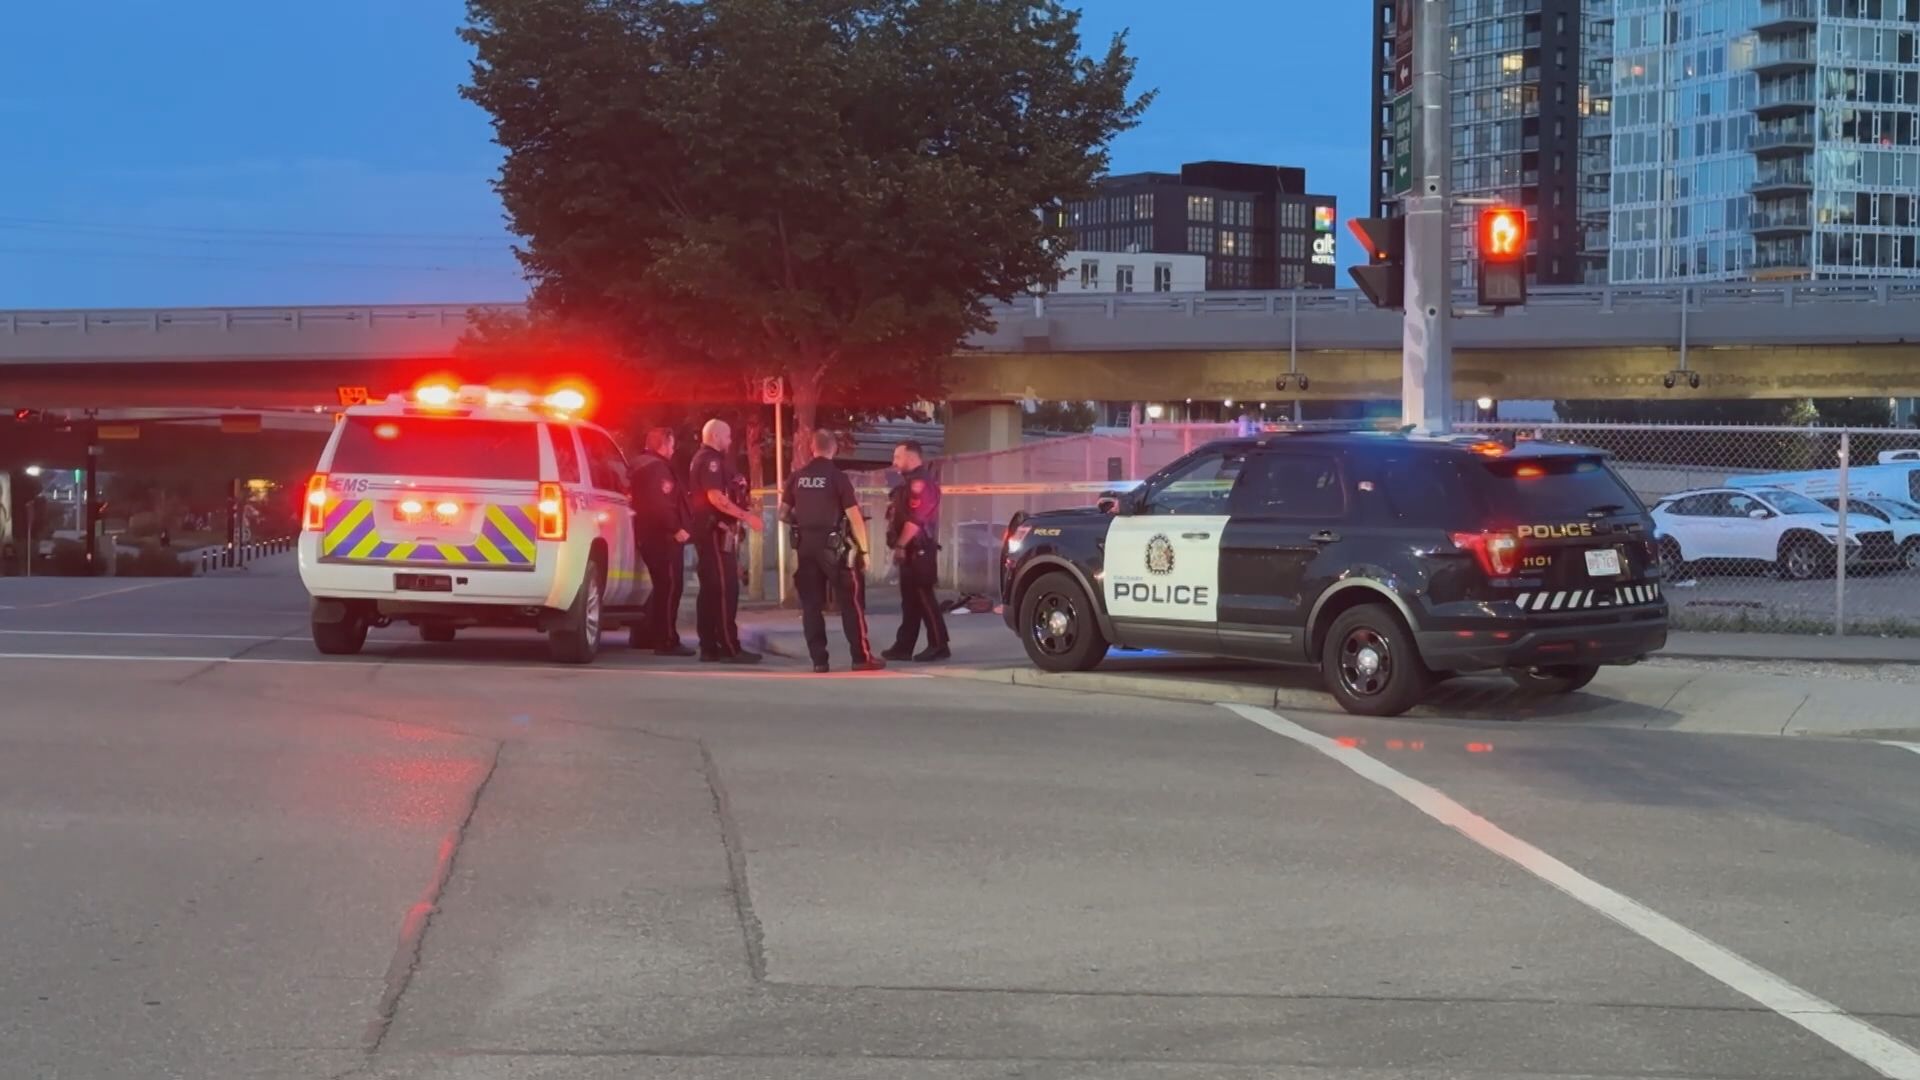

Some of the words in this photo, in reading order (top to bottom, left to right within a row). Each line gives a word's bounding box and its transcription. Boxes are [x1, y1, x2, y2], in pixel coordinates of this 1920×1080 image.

[1313, 233, 1335, 254] alt
[333, 477, 369, 492] EMS
[798, 477, 826, 489] POLICE
[1518, 523, 1592, 538] POLICE
[1523, 555, 1551, 567] 1101
[1114, 583, 1209, 605] POLICE
